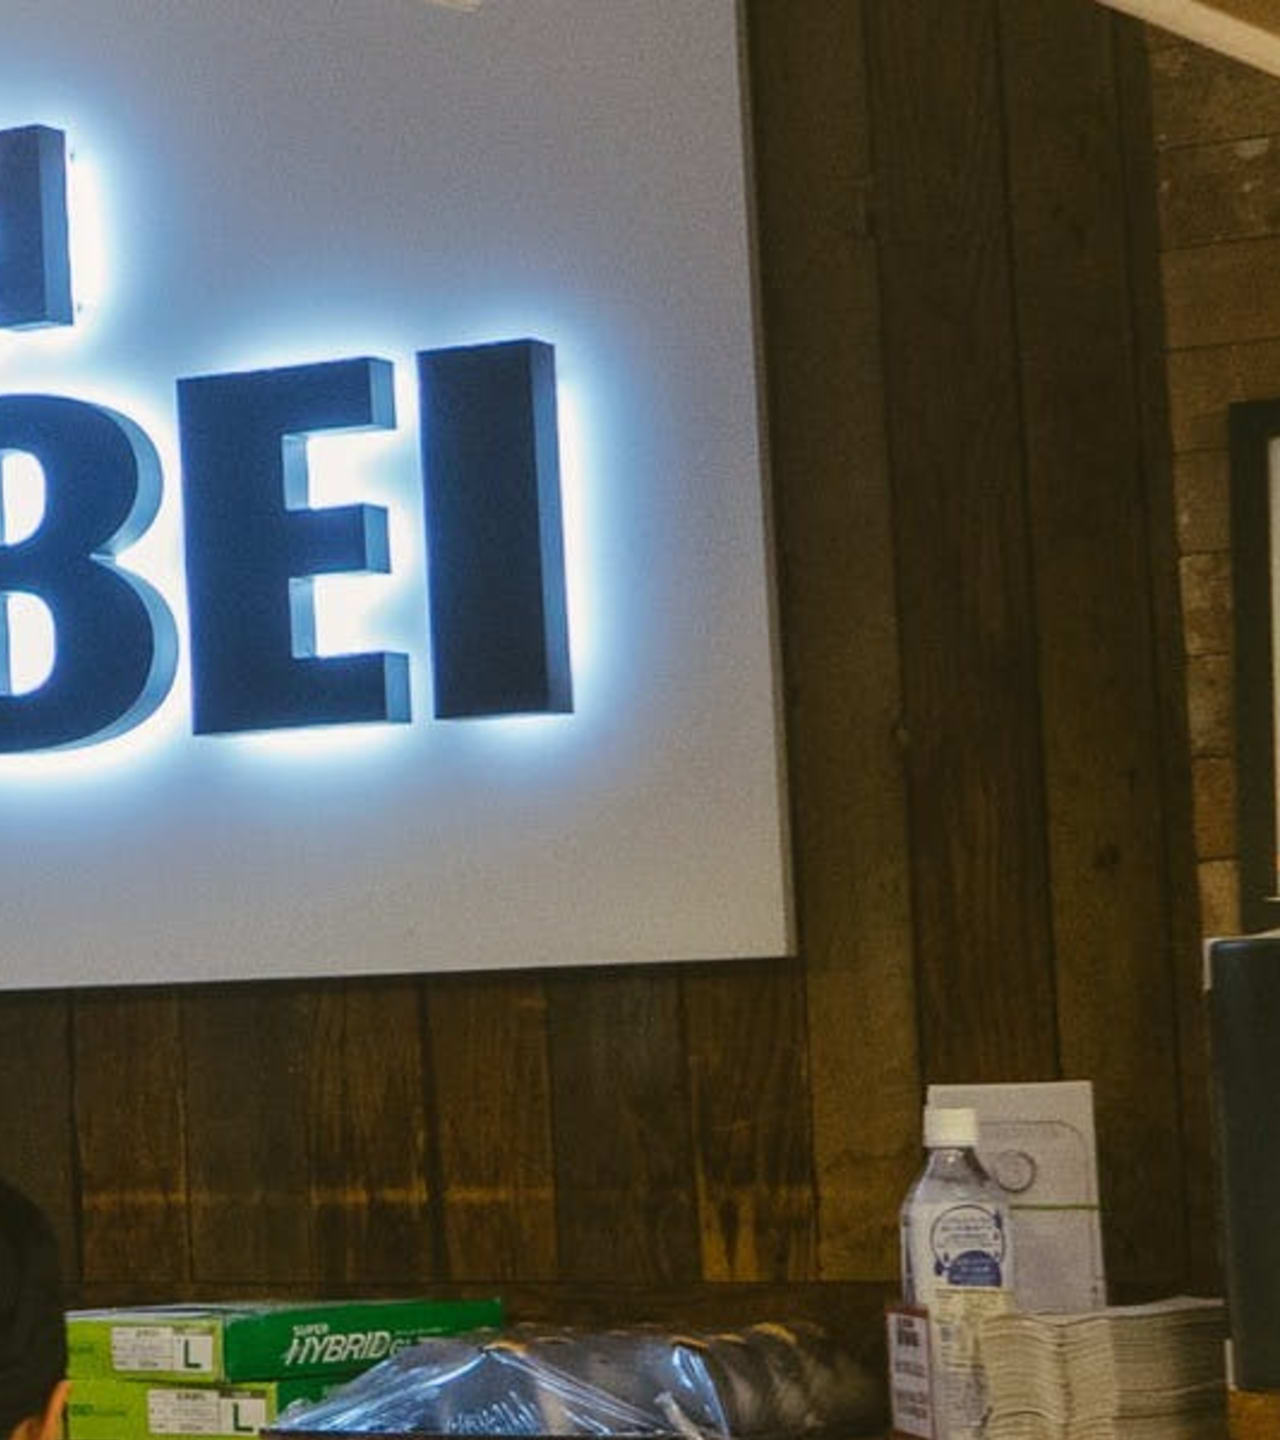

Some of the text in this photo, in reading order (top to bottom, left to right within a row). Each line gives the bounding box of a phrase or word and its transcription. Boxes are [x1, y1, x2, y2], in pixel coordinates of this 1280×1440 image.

[184, 1339, 202, 1368] L
[284, 1331, 391, 1365] HYBRID
[233, 1402, 253, 1432] L
